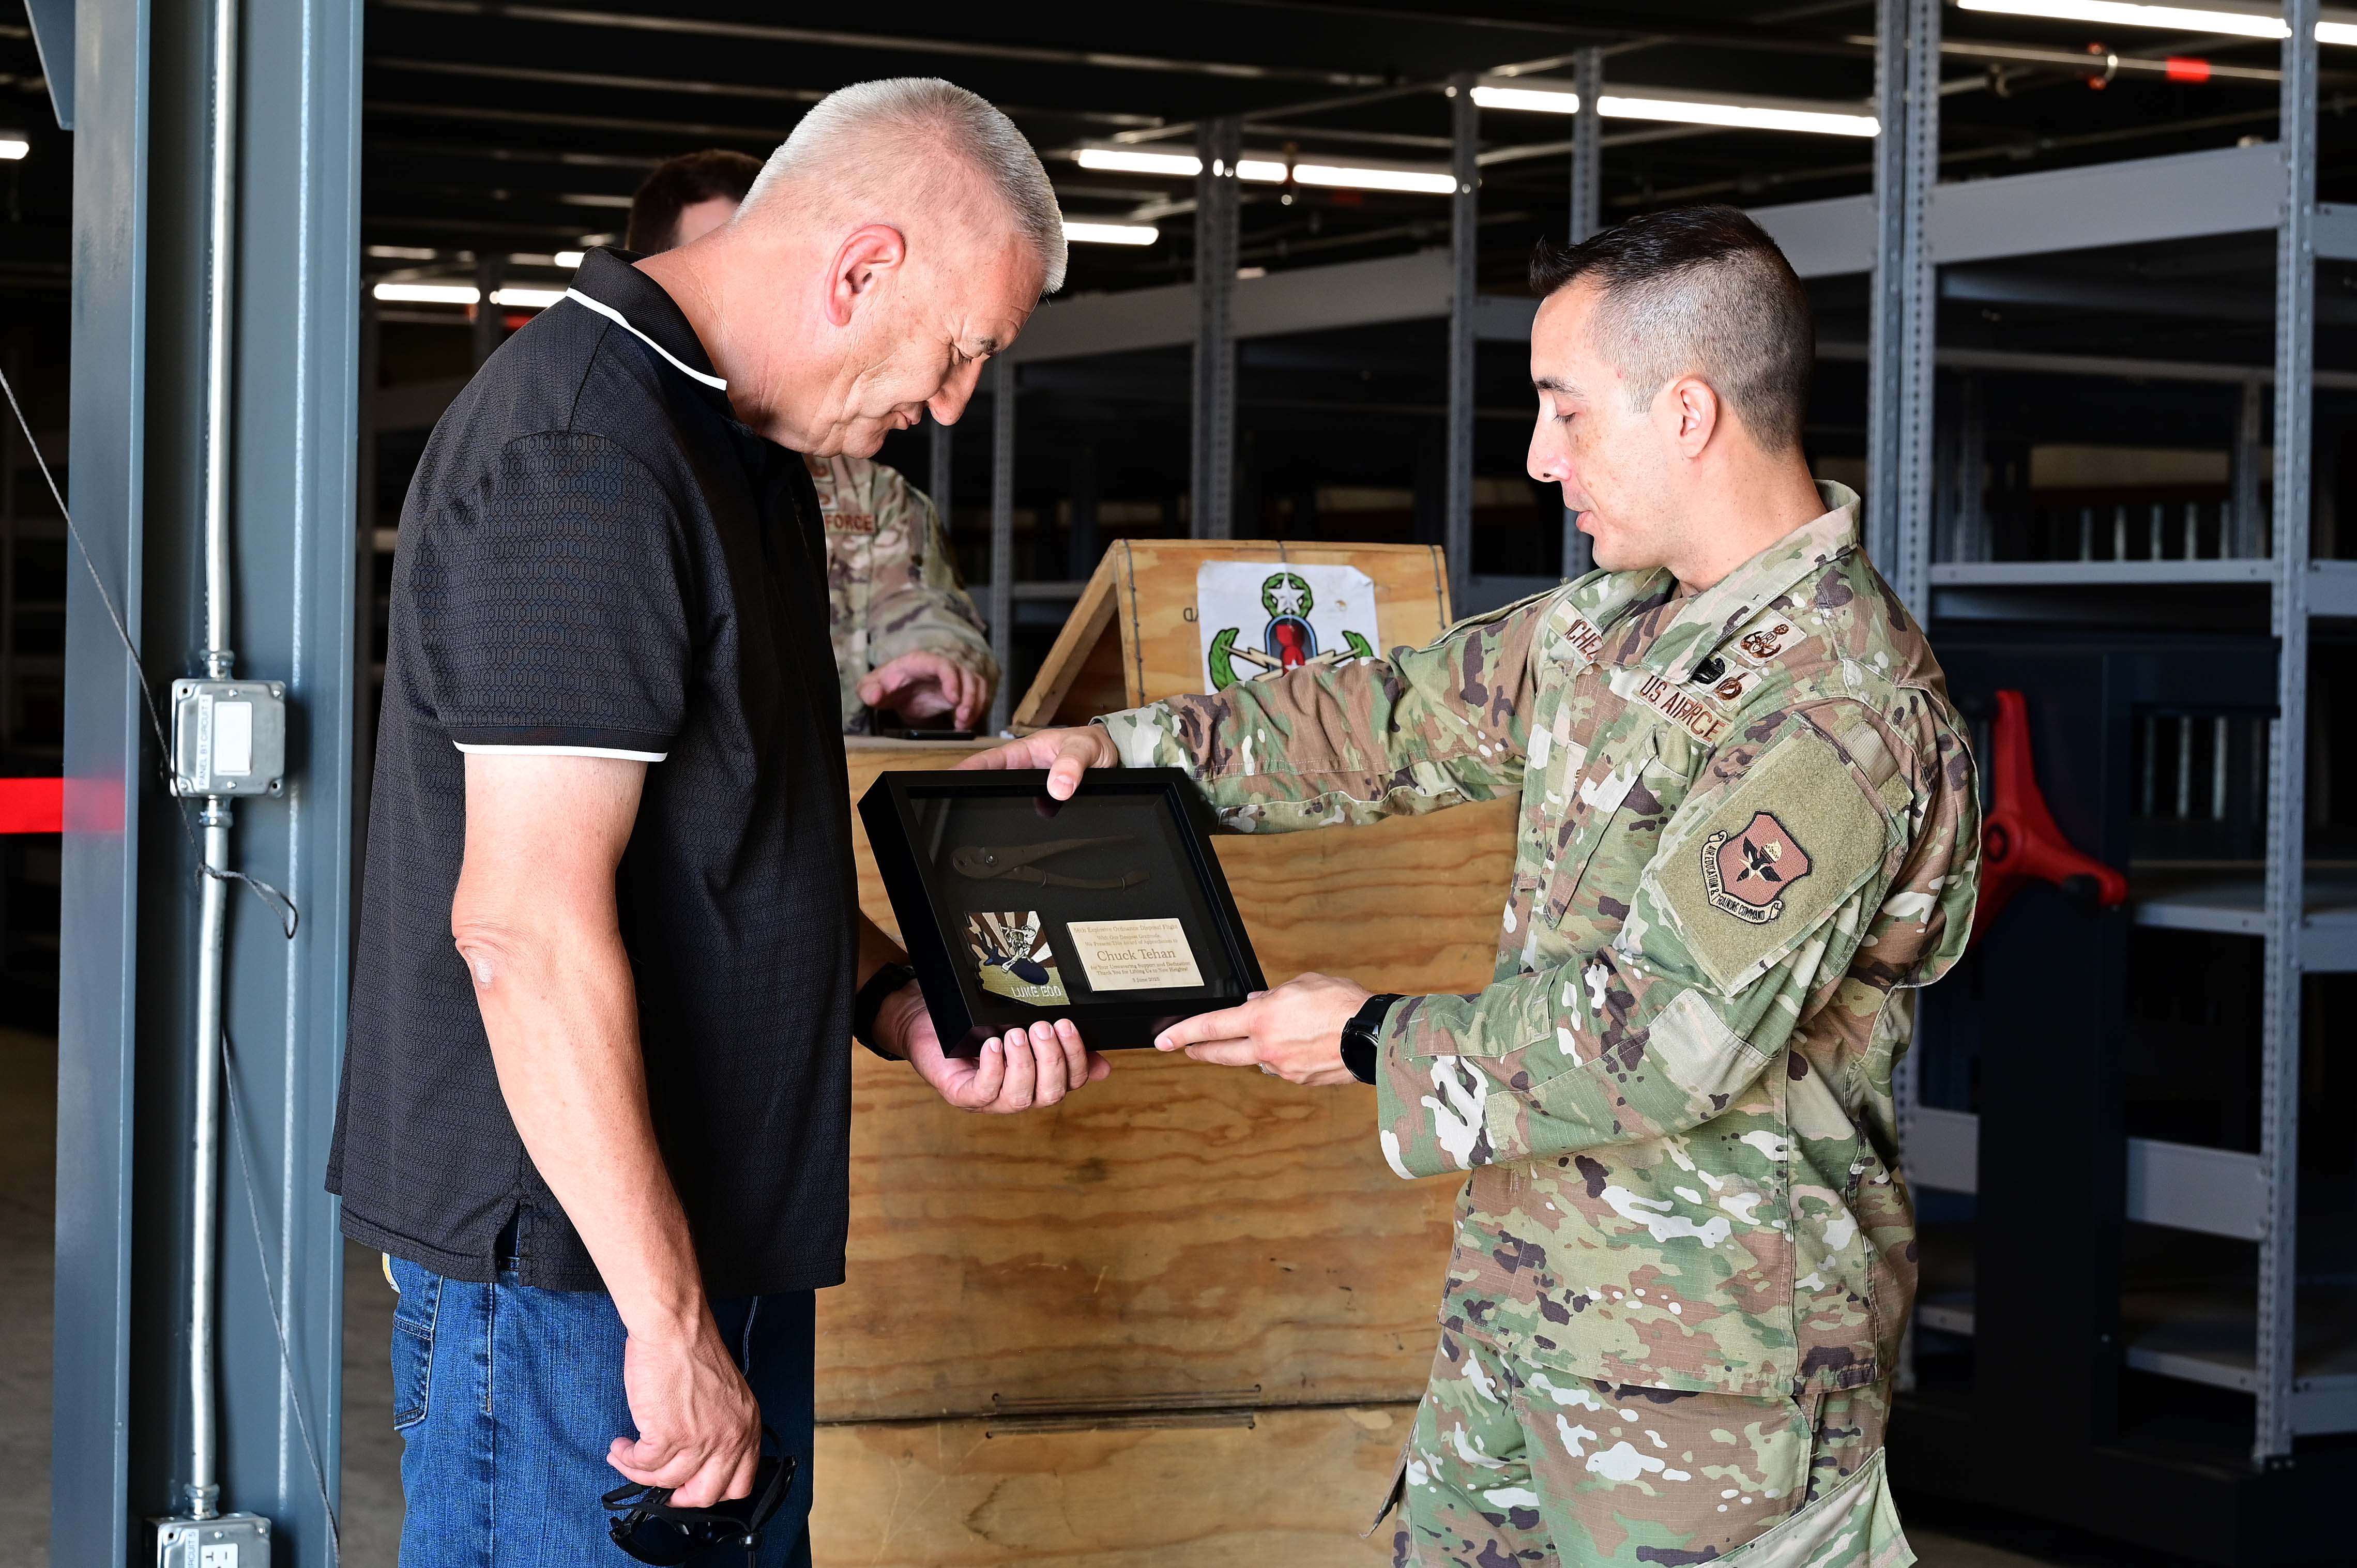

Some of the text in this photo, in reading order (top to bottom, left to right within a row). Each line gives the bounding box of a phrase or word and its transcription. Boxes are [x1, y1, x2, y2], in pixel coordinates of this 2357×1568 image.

[824, 514, 874, 531] FORCE
[1706, 845, 1716, 855] AIR
[1705, 857, 1719, 888] EDUCATION
[1711, 893, 1766, 921] TRAINING COMMAND
[1097, 948, 1177, 961] Chuck Tehan
[1011, 985, 1062, 997] LUKE EOD
